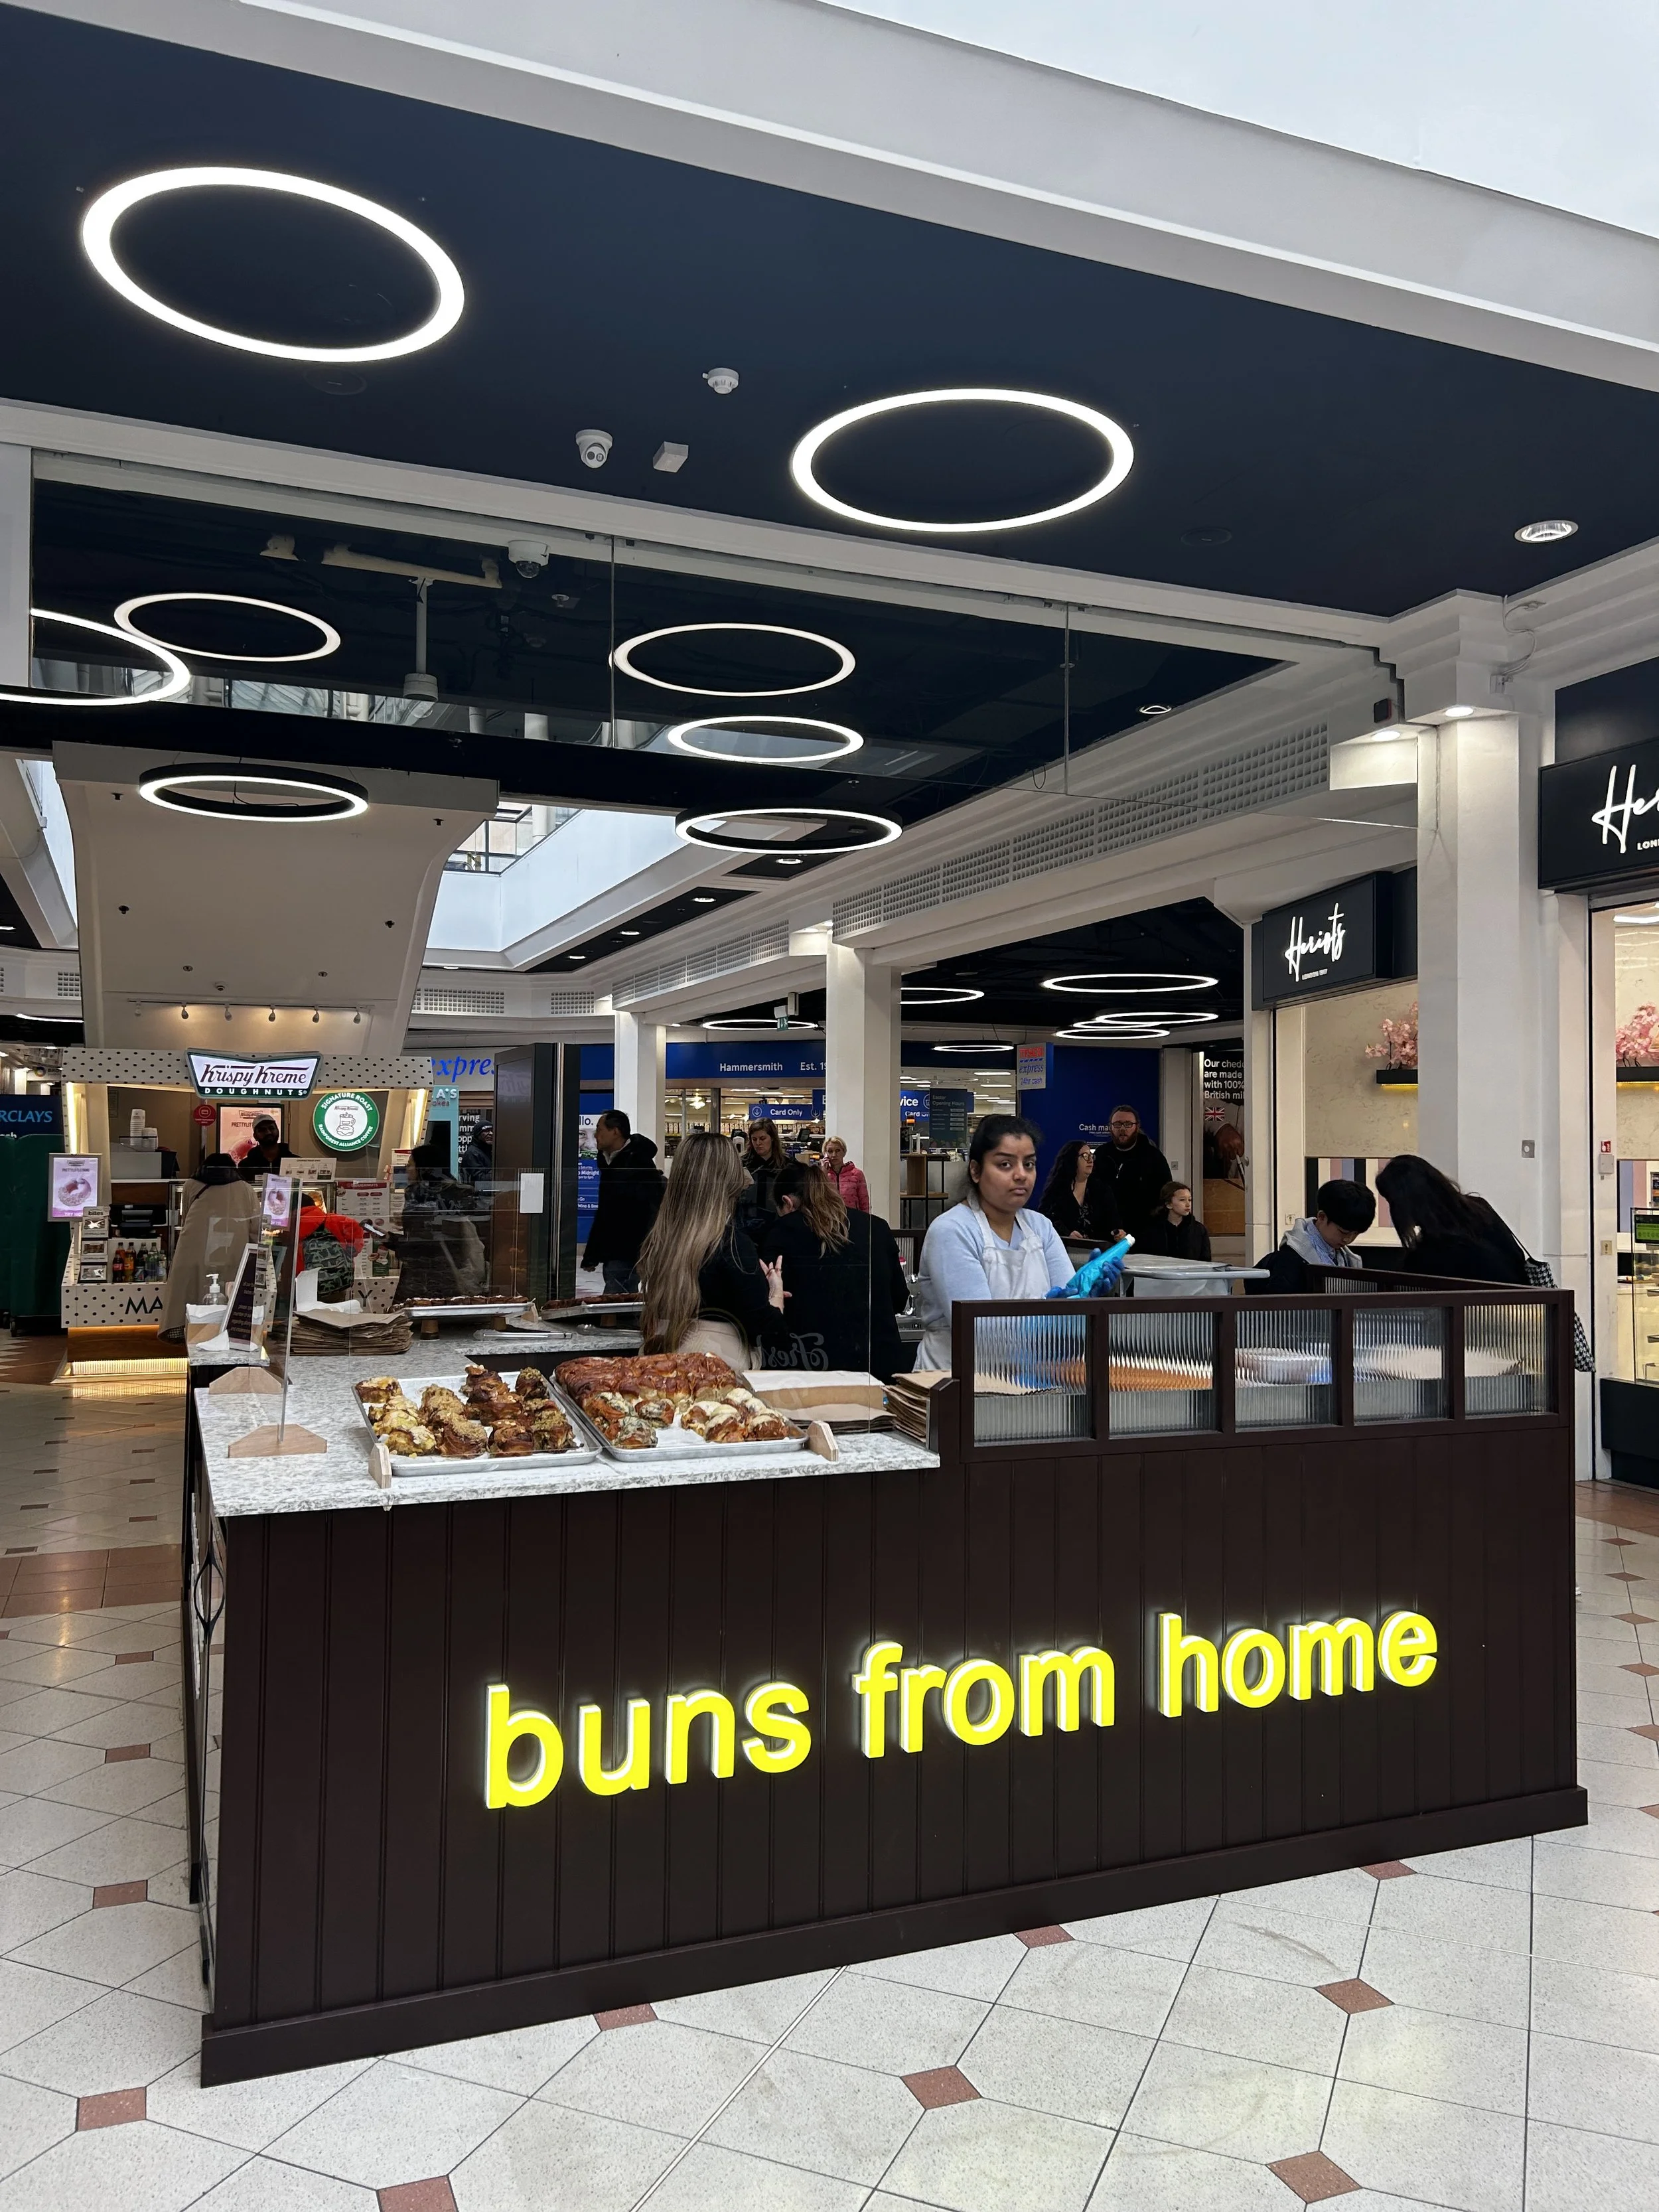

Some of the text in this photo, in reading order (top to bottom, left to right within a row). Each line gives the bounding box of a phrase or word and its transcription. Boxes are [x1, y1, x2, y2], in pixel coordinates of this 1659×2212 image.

[1591, 765, 1659, 853] He
[1637, 839, 1659, 850] LON
[719, 1063, 783, 1072] Hammersmith
[800, 1062, 817, 1070] Est.
[1204, 1059, 1220, 1067] Our
[200, 1064, 309, 1086] Krispy Kreme
[1019, 1065, 1043, 1075] express
[1220, 1070, 1242, 1078] made
[1204, 1080, 1244, 1089] with 100%
[1204, 1090, 1230, 1099] British
[321, 1092, 373, 1112] SIGNATURE ROAST
[787, 1108, 802, 1117] Only
[318, 1124, 340, 1145] RAINFOREST
[360, 1126, 374, 1142] COFFEE
[484, 1611, 1437, 1809] buns from home
